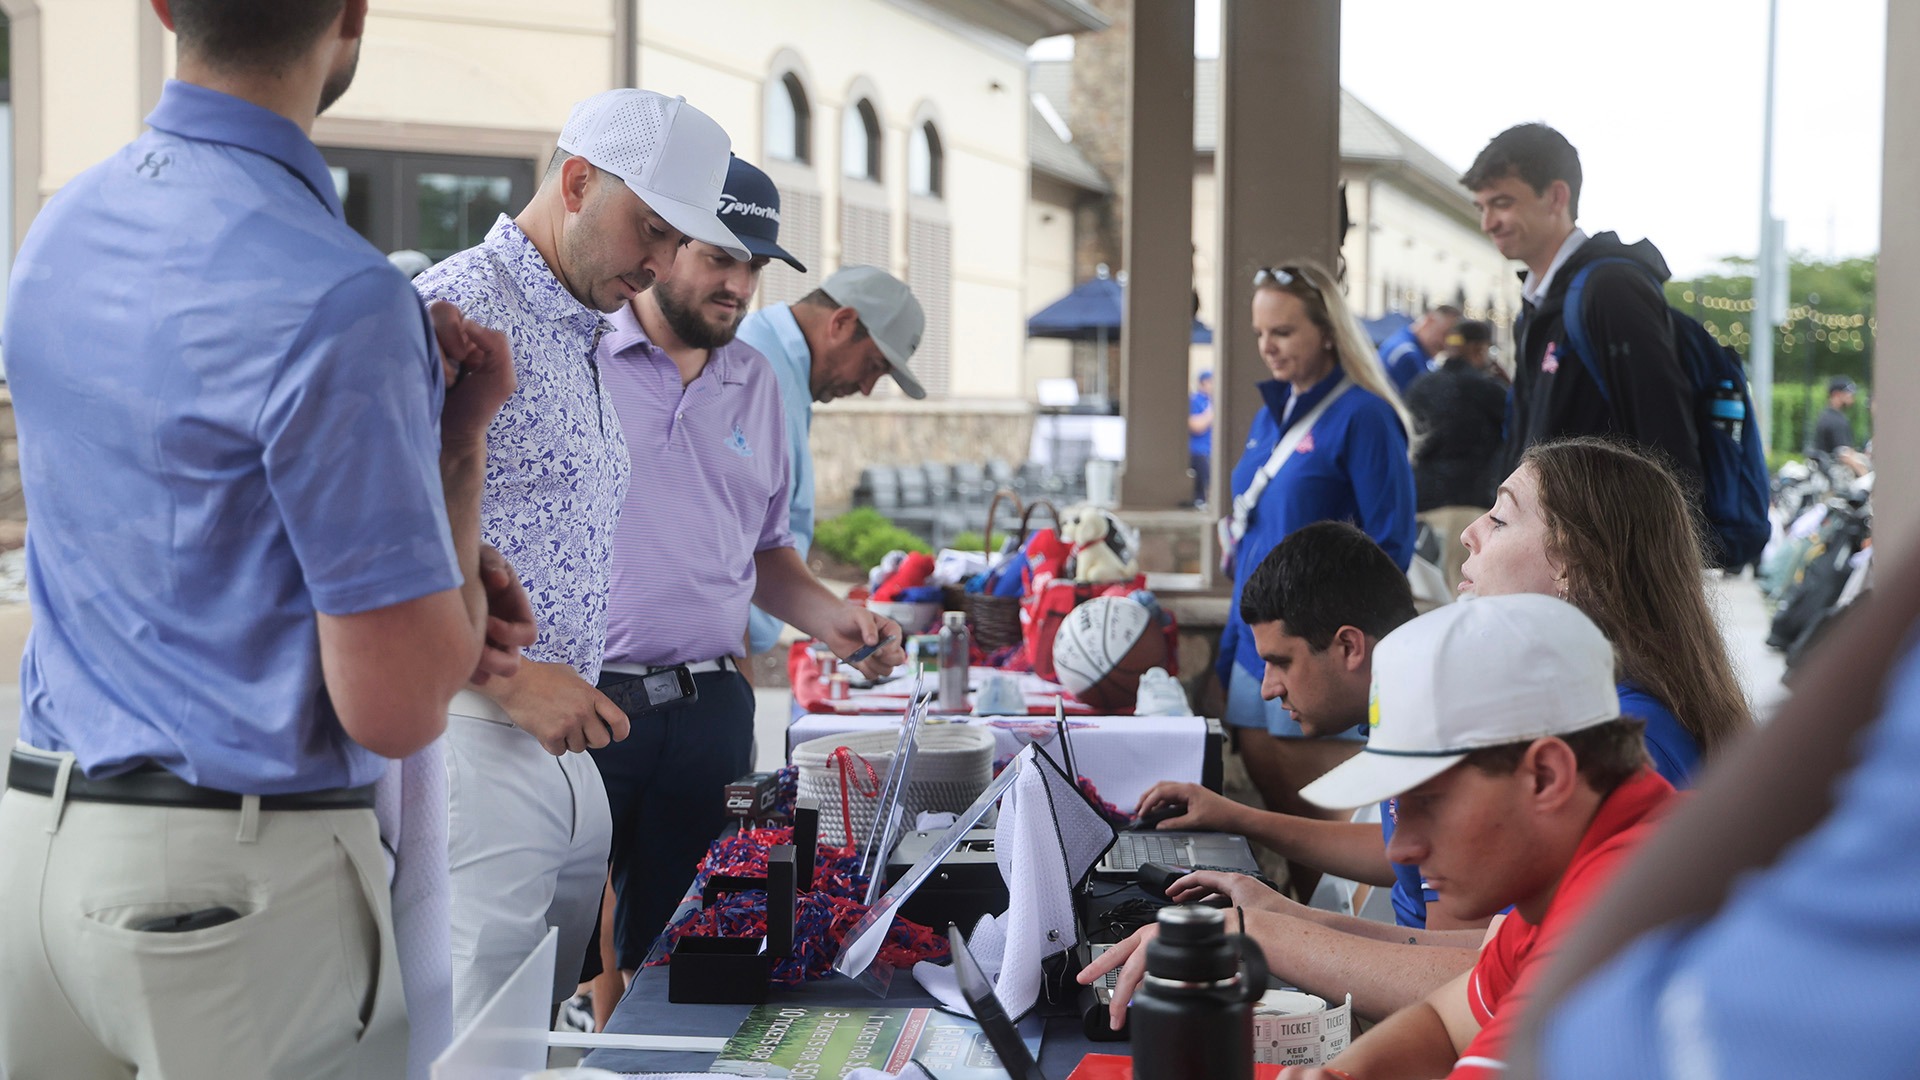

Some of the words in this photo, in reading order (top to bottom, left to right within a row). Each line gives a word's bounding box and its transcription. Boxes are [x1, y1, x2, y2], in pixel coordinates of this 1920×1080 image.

[778, 1008, 809, 1017] 10
[1326, 1013, 1345, 1029] TICKET
[760, 1018, 794, 1045] TICKETS
[807, 1019, 839, 1046] TICKETS
[856, 1021, 884, 1044] TICKET
[1281, 1022, 1312, 1036] TICKET
[924, 1028, 965, 1070] RAFFLE
[1330, 1038, 1343, 1048] KEEP
[749, 1046, 776, 1059] FOR
[798, 1047, 823, 1061] FOR
[847, 1045, 872, 1060] FOR
[1286, 1046, 1308, 1055] KEEP
[1281, 1057, 1314, 1067] COUPON
